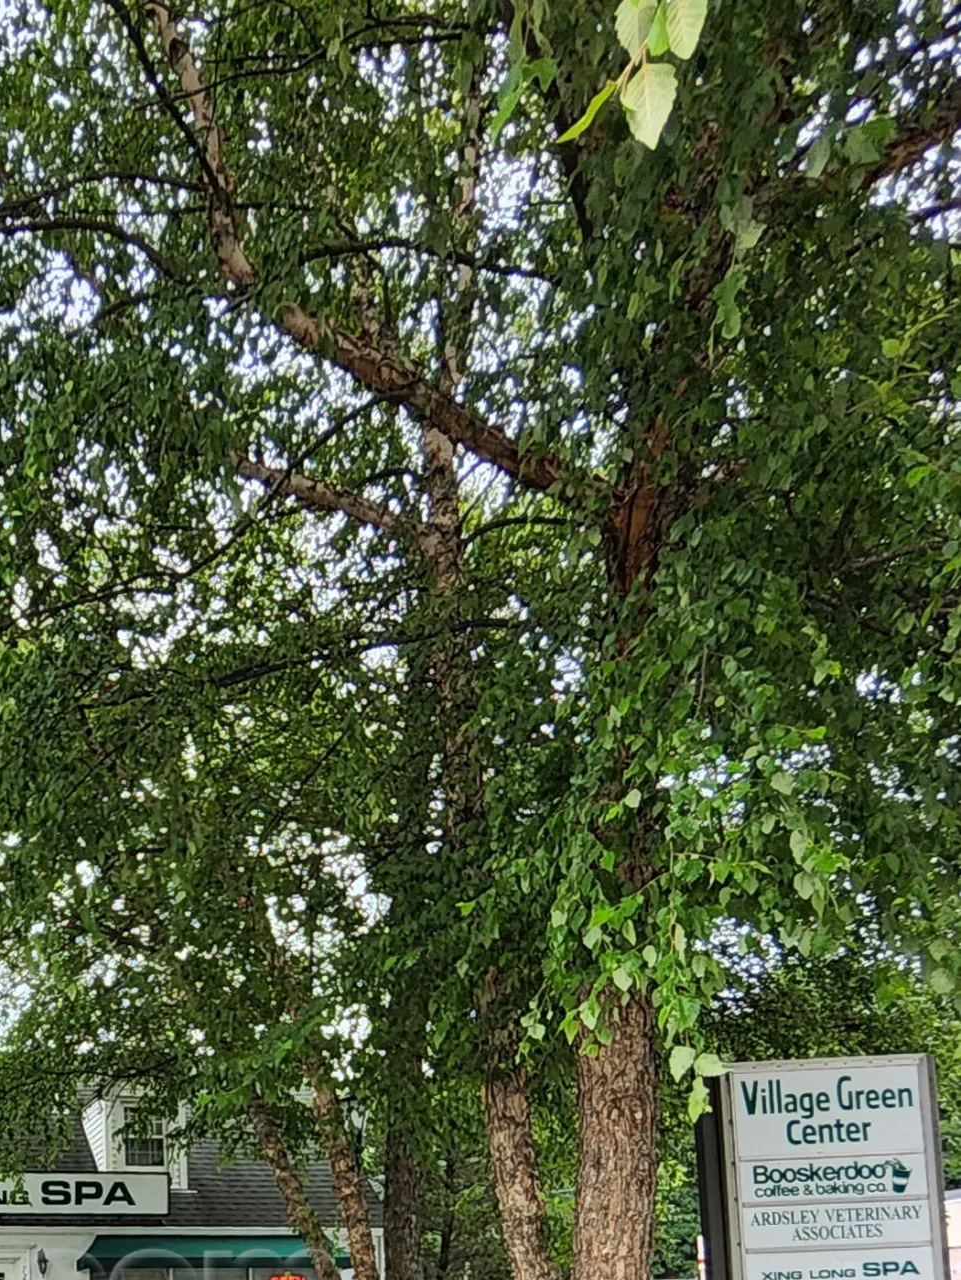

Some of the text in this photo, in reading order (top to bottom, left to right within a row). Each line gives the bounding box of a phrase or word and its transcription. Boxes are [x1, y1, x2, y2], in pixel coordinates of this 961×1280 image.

[740, 1076, 913, 1119] Village Green
[786, 1119, 872, 1145] Center
[753, 1160, 887, 1185] Booskerdoo
[41, 1180, 137, 1206] SPA
[754, 1184, 800, 1199] coffee
[803, 1183, 814, 1196] &
[816, 1181, 865, 1196] baking
[750, 1205, 922, 1227] ARDSLEY VETERINARY
[792, 1223, 883, 1242] ASSOCIATES
[809, 1268, 856, 1280] LONG
[862, 1260, 921, 1278] SPA
